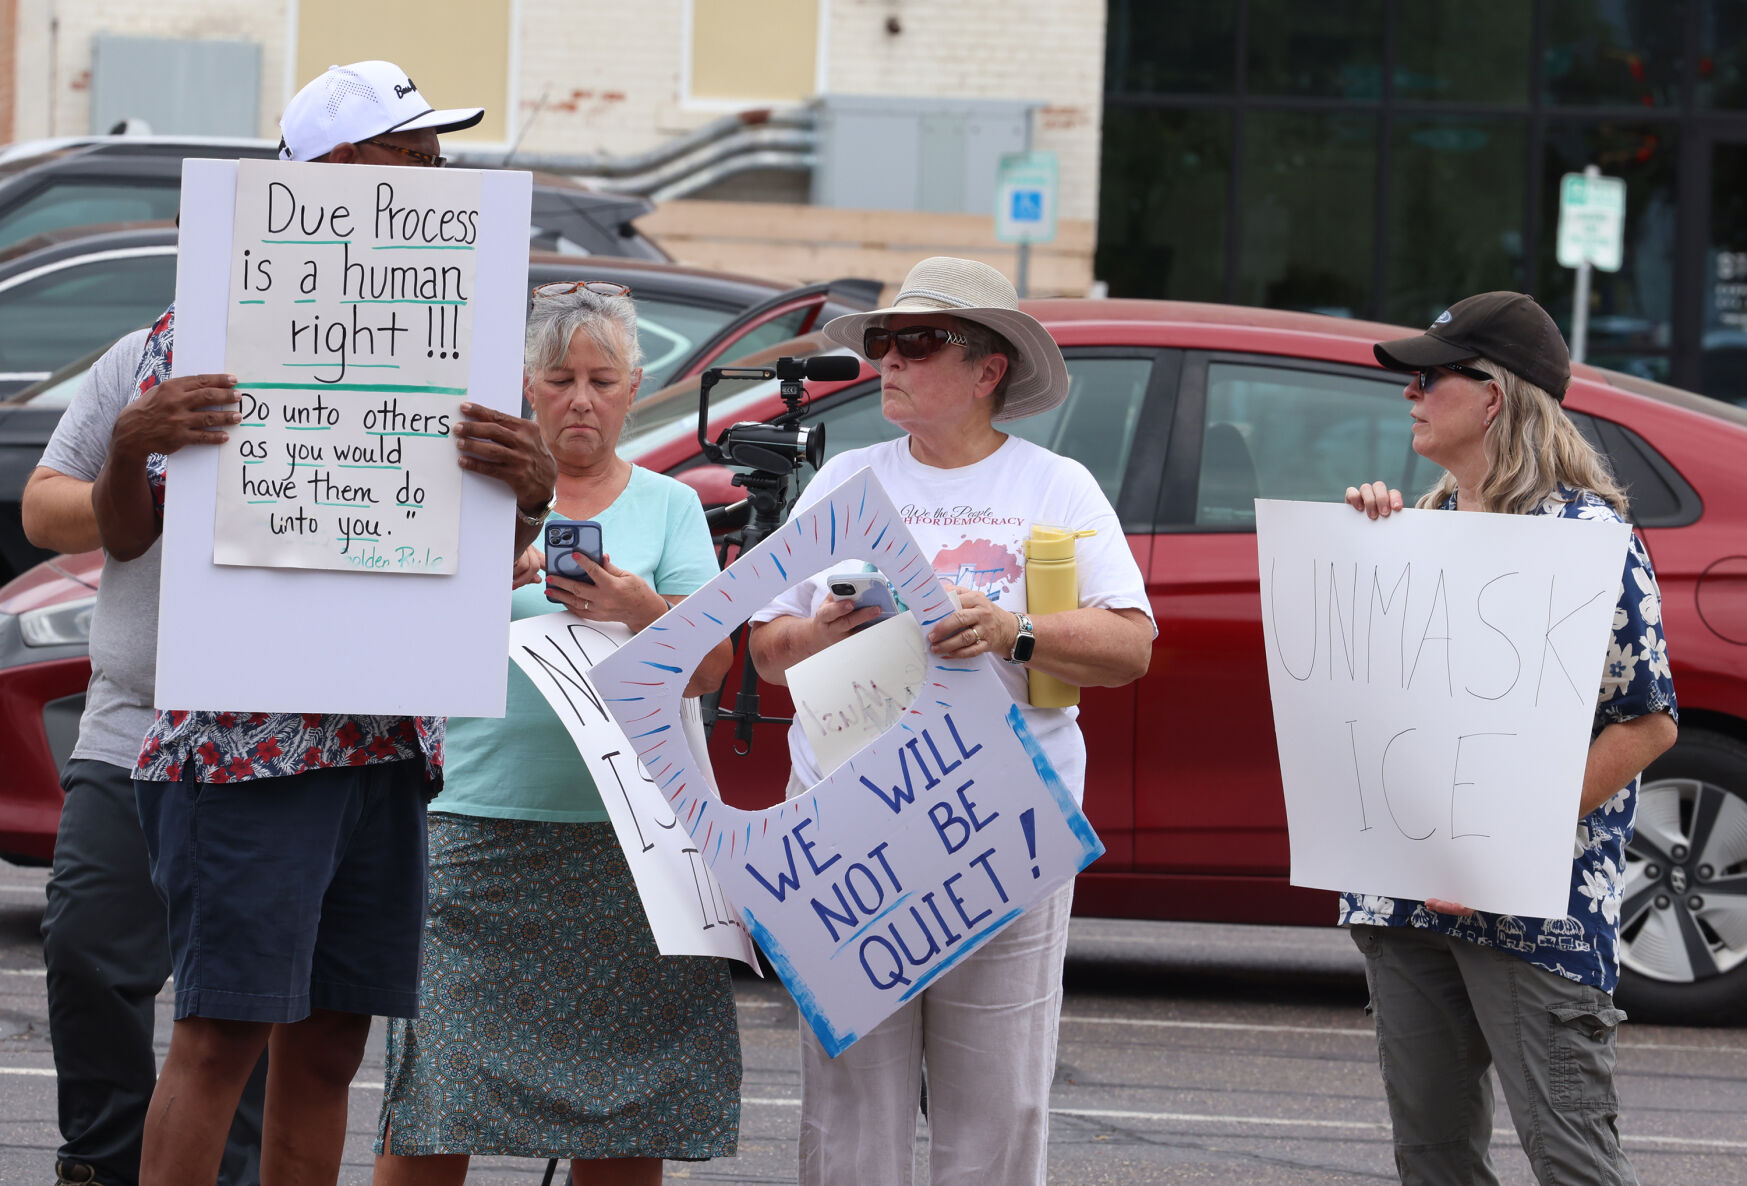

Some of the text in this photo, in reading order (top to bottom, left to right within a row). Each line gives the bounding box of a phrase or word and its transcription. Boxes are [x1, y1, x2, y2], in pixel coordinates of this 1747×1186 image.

[268, 181, 479, 245] Due Process
[243, 242, 468, 301] is a human
[291, 304, 409, 384] right
[239, 392, 451, 436] Do unto others
[239, 434, 402, 482] as you would
[242, 464, 425, 505] have them do
[270, 505, 319, 535] unto
[900, 503, 995, 519] We the People
[915, 516, 941, 526] FOR
[943, 516, 1025, 527] DEMOCRACY
[343, 546, 390, 569] olden
[1270, 556, 1607, 708] UNMASK
[1344, 719, 1518, 841] ICE
[744, 712, 984, 903] WE WILL
[809, 778, 1000, 944] NOT BE
